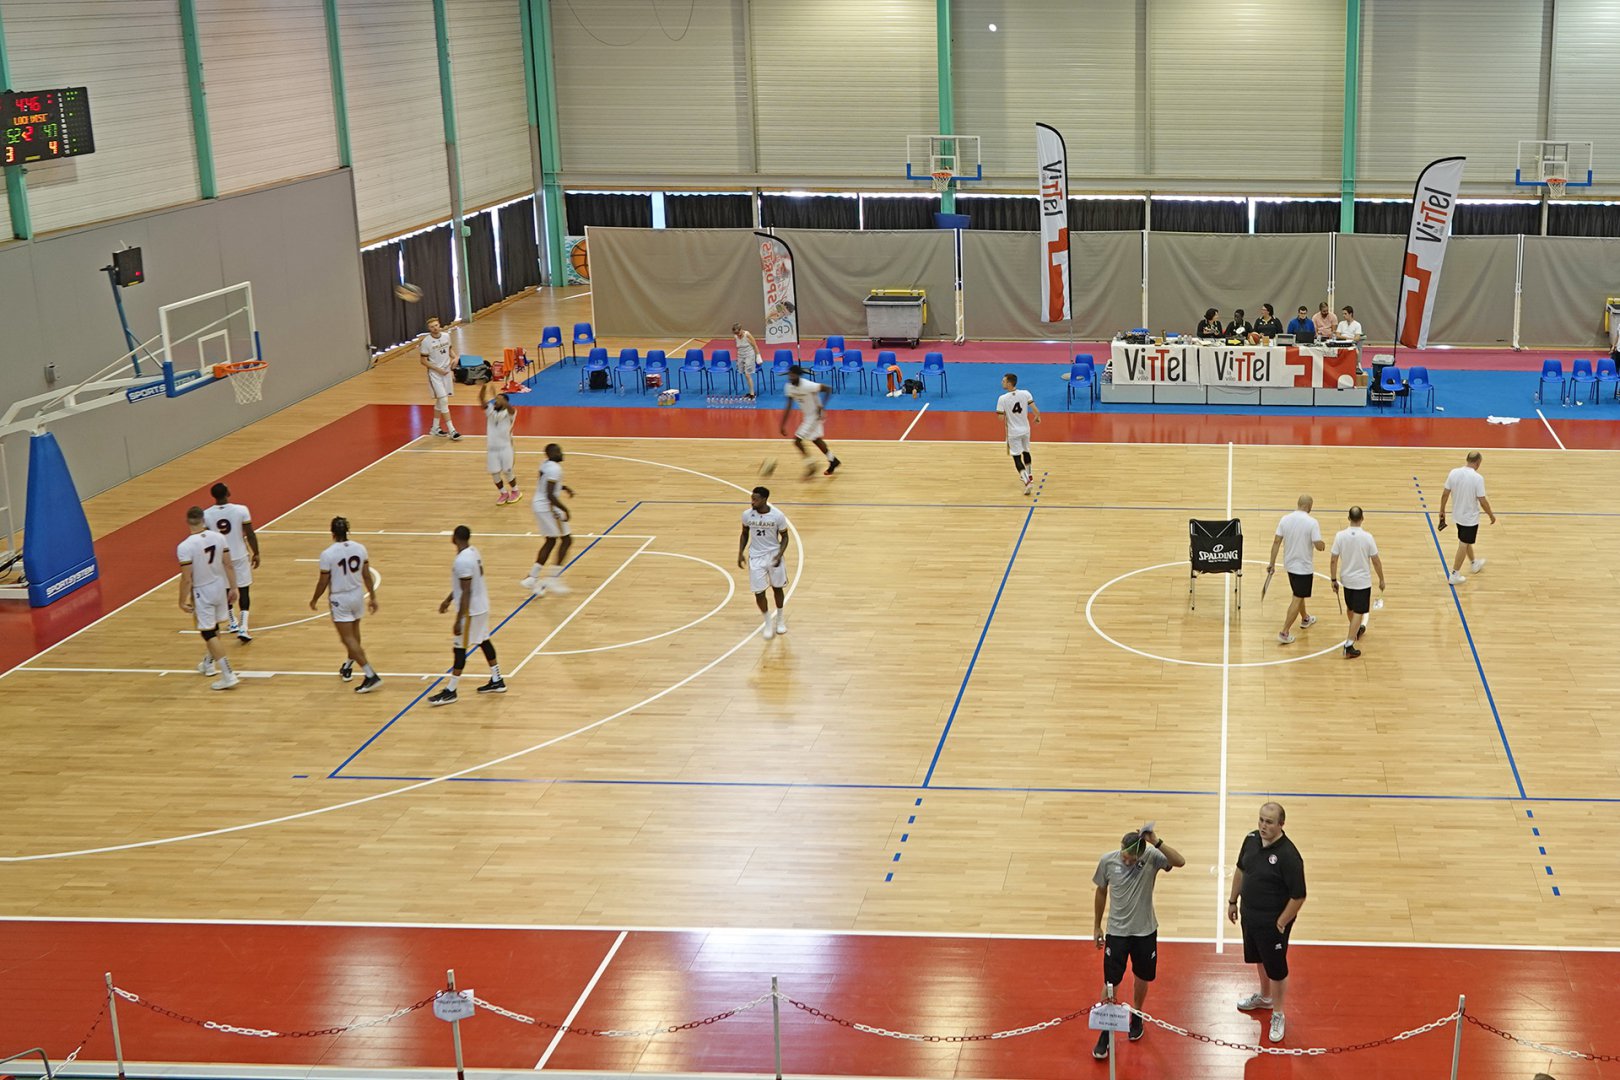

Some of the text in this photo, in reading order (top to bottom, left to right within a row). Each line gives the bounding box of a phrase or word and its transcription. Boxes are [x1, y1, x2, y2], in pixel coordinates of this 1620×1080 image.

[25, 126, 34, 141] 2
[5, 141, 57, 162] 3 4
[1012, 402, 1023, 414] 4
[216, 518, 231, 535] 9
[756, 529, 766, 537] 21
[204, 544, 216, 564] 7
[1198, 549, 1239, 561] SPALDING
[337, 555, 361, 576] 10
